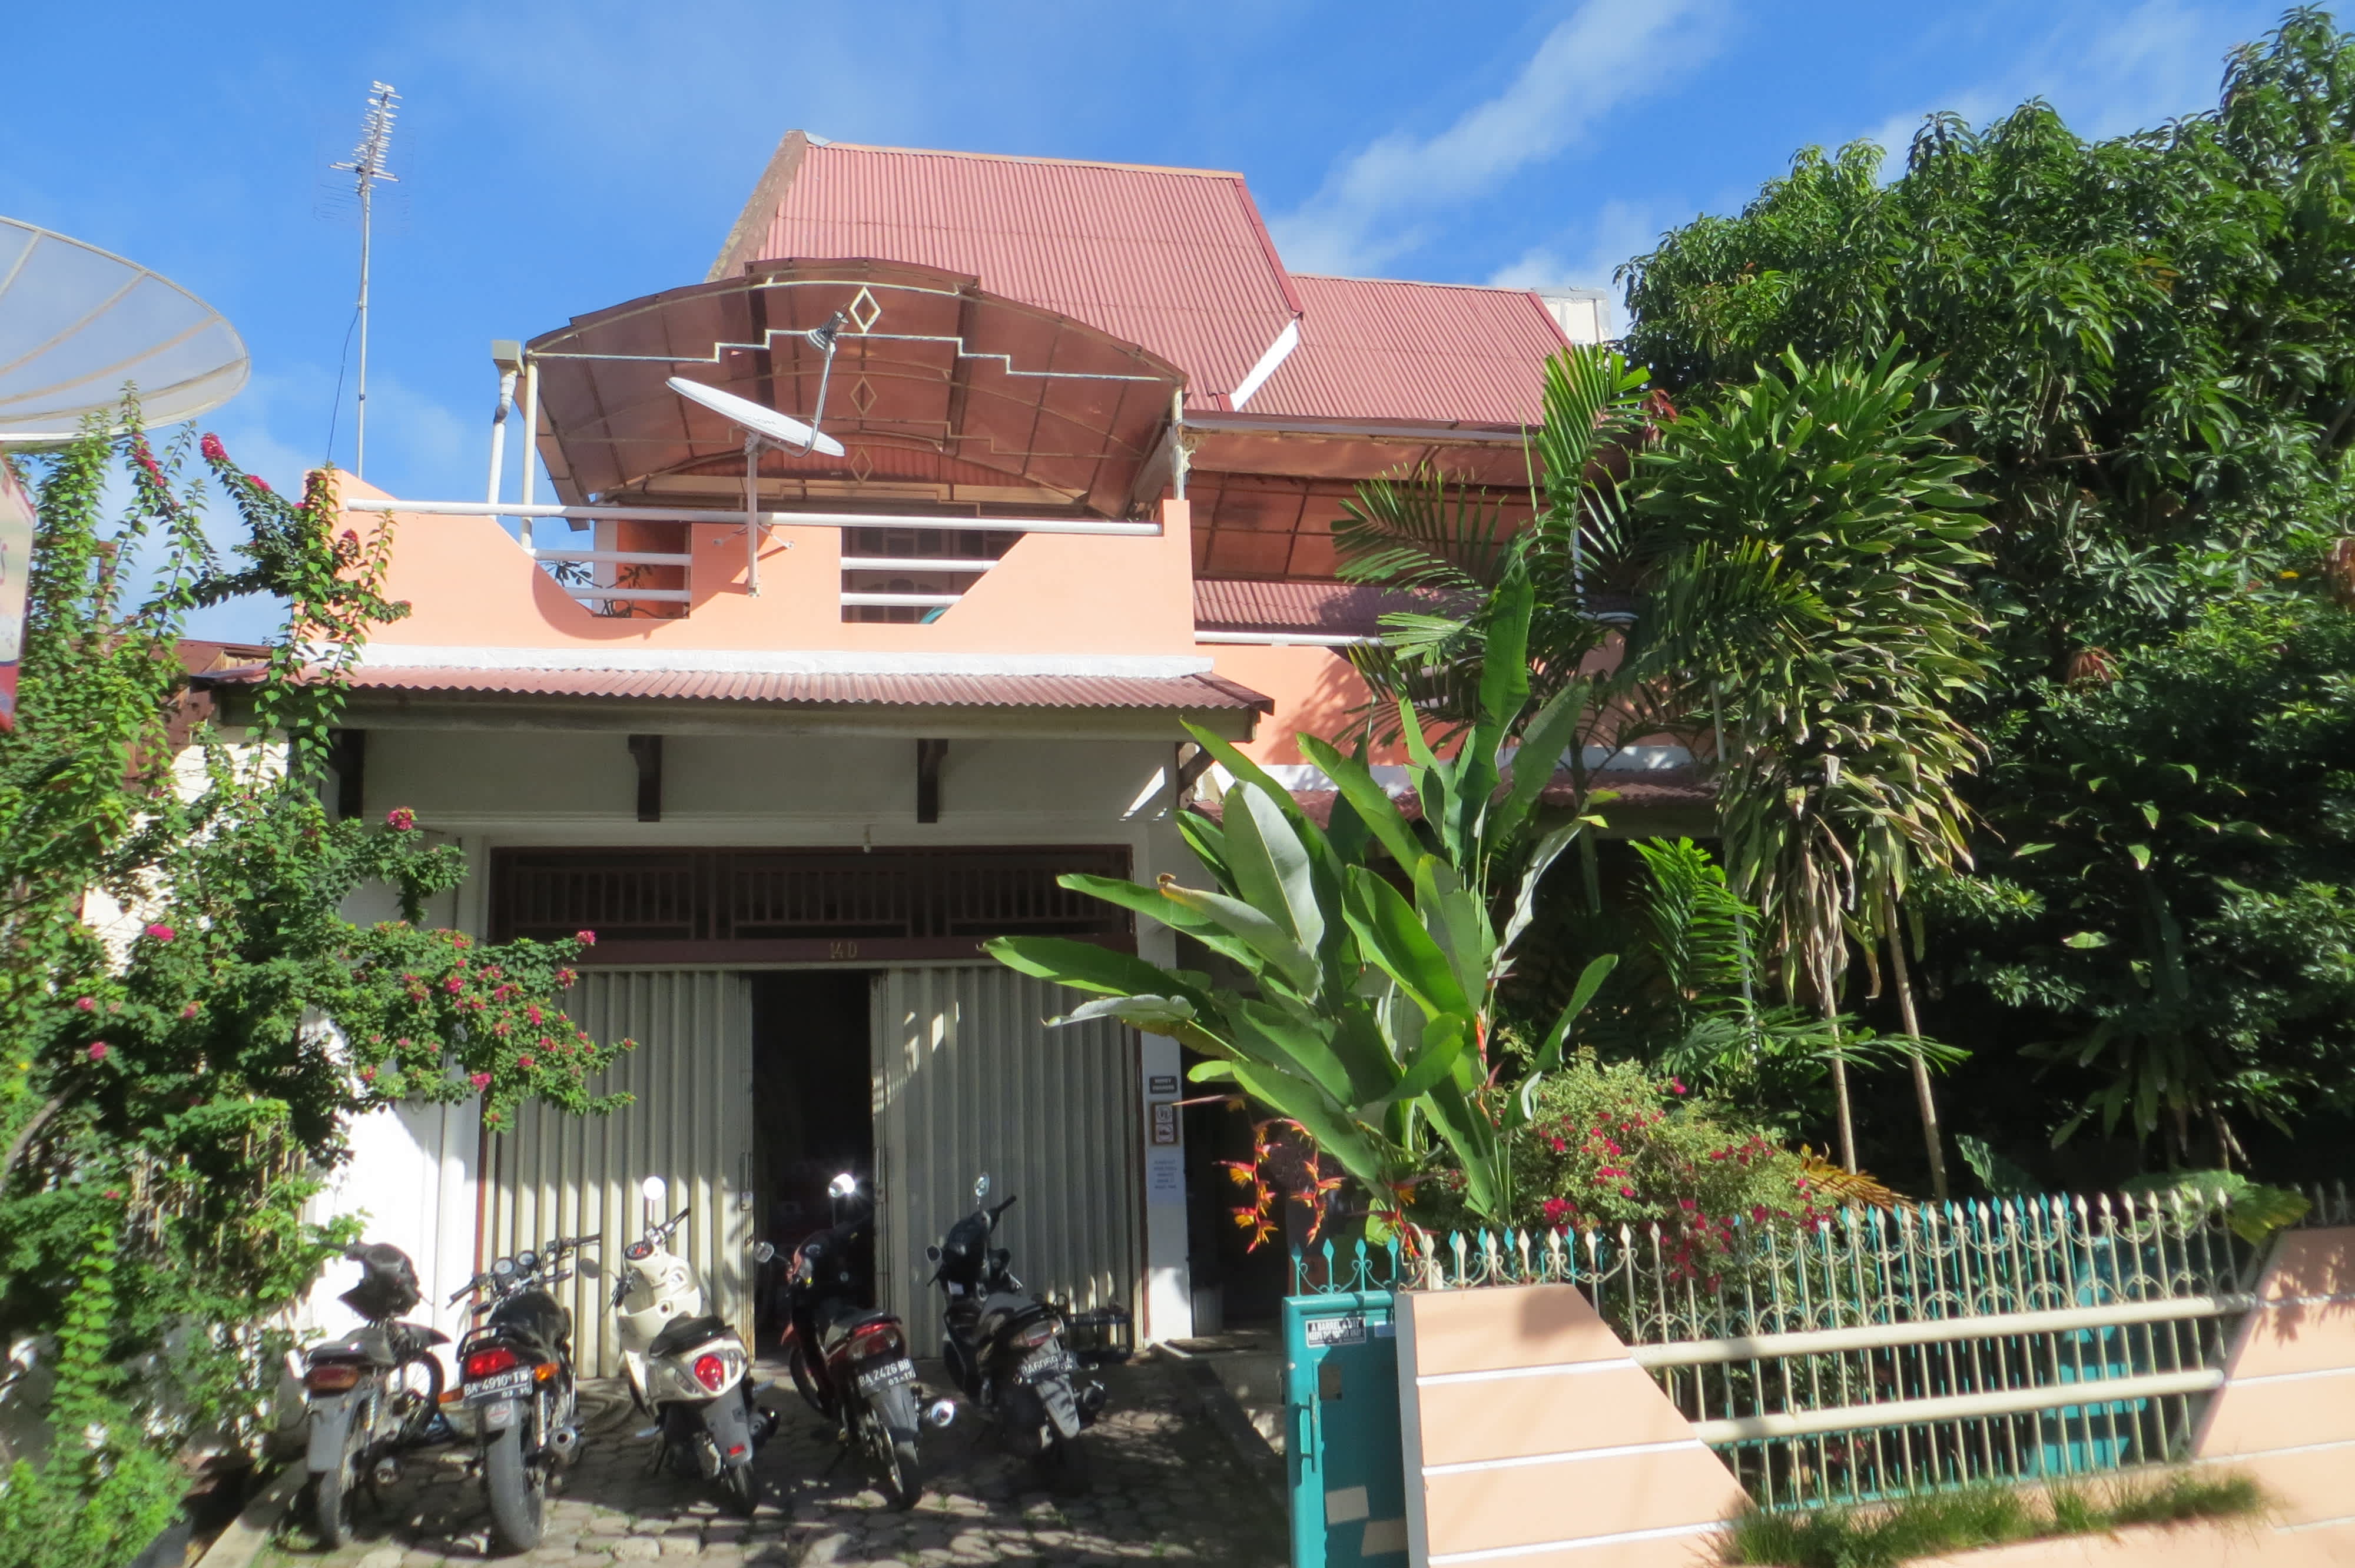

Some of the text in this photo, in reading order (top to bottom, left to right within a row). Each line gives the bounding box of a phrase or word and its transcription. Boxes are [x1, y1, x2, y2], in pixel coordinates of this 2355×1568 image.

[482, 1374, 509, 1390] 4910
[858, 1372, 874, 1386] BA
[873, 1363, 898, 1381] 2426
